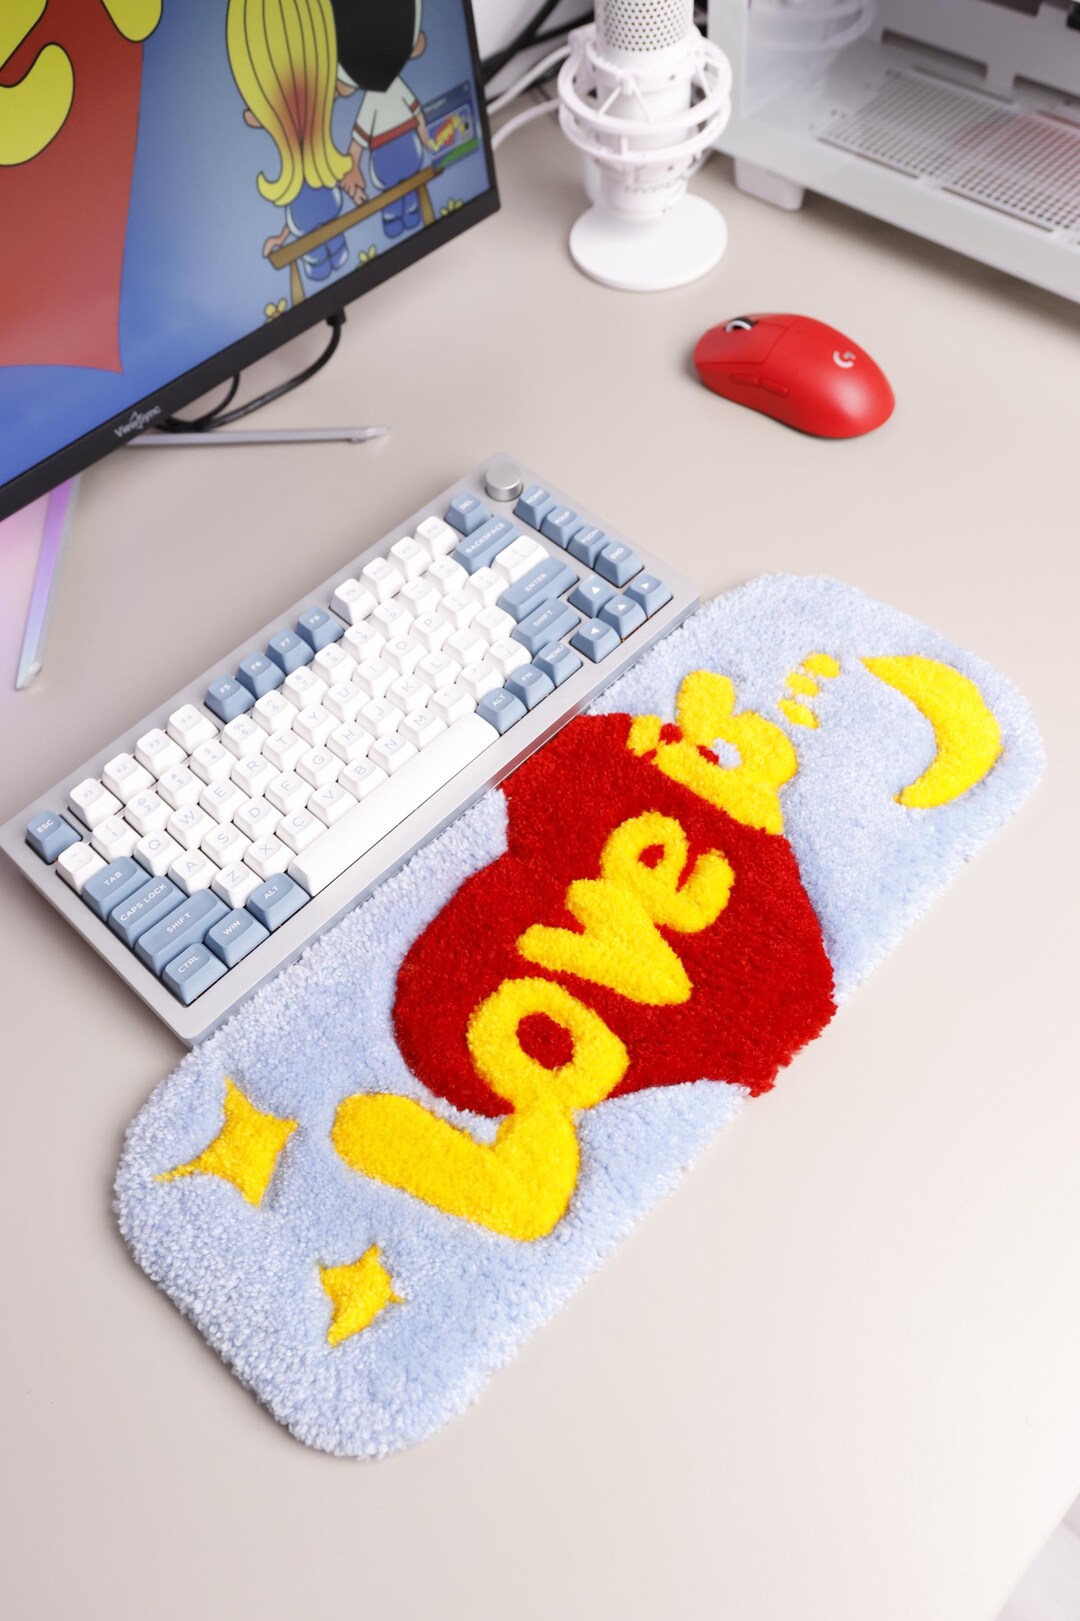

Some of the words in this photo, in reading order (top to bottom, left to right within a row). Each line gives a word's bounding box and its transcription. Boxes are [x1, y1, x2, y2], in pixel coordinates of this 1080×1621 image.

[465, 522, 505, 554] BACKSPACE
[523, 573, 547, 592] ENTER
[532, 609, 553, 627] SHIFT
[492, 694, 506, 706] ALT
[213, 786, 227, 798] E
[179, 809, 195, 825] W
[248, 807, 261, 818] D
[36, 819, 55, 833] ESC
[292, 816, 305, 827] C
[148, 838, 161, 850] Q
[216, 832, 229, 844] S
[259, 842, 273, 854] X
[184, 861, 198, 872] A
[103, 870, 123, 887] TAB
[227, 870, 240, 882] Z
[263, 884, 280, 900] ALT
[119, 901, 144, 921] CAPS
[143, 882, 168, 903] LOCK
[166, 911, 193, 935] SHIFT
[222, 919, 241, 936] WIN
[177, 953, 201, 973] CTRL
[331, 809, 736, 1242] Love
